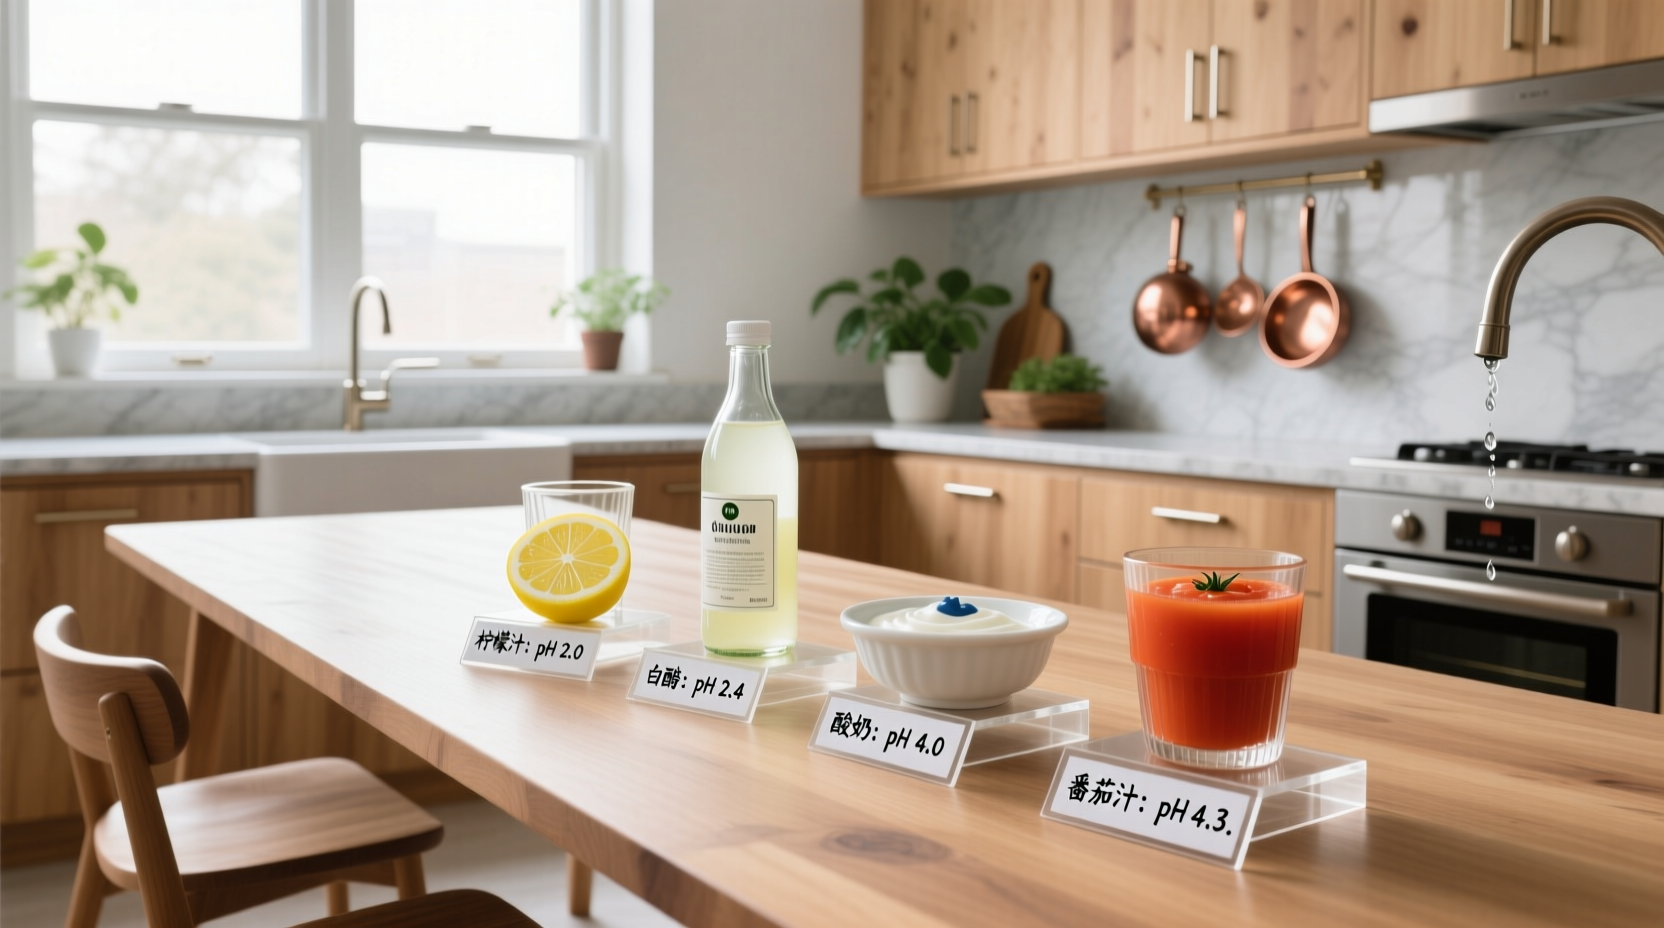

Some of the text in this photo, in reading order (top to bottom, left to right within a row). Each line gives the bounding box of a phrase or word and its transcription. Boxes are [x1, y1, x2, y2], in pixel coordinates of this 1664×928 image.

[534, 640, 558, 662] pH
[559, 642, 584, 660] 2.0
[691, 676, 717, 698] pH
[718, 679, 745, 700] 2.4
[883, 727, 912, 753] pH
[915, 733, 945, 757] 4.0
[1153, 797, 1189, 826] pH
[1191, 804, 1232, 836] 4.3.
